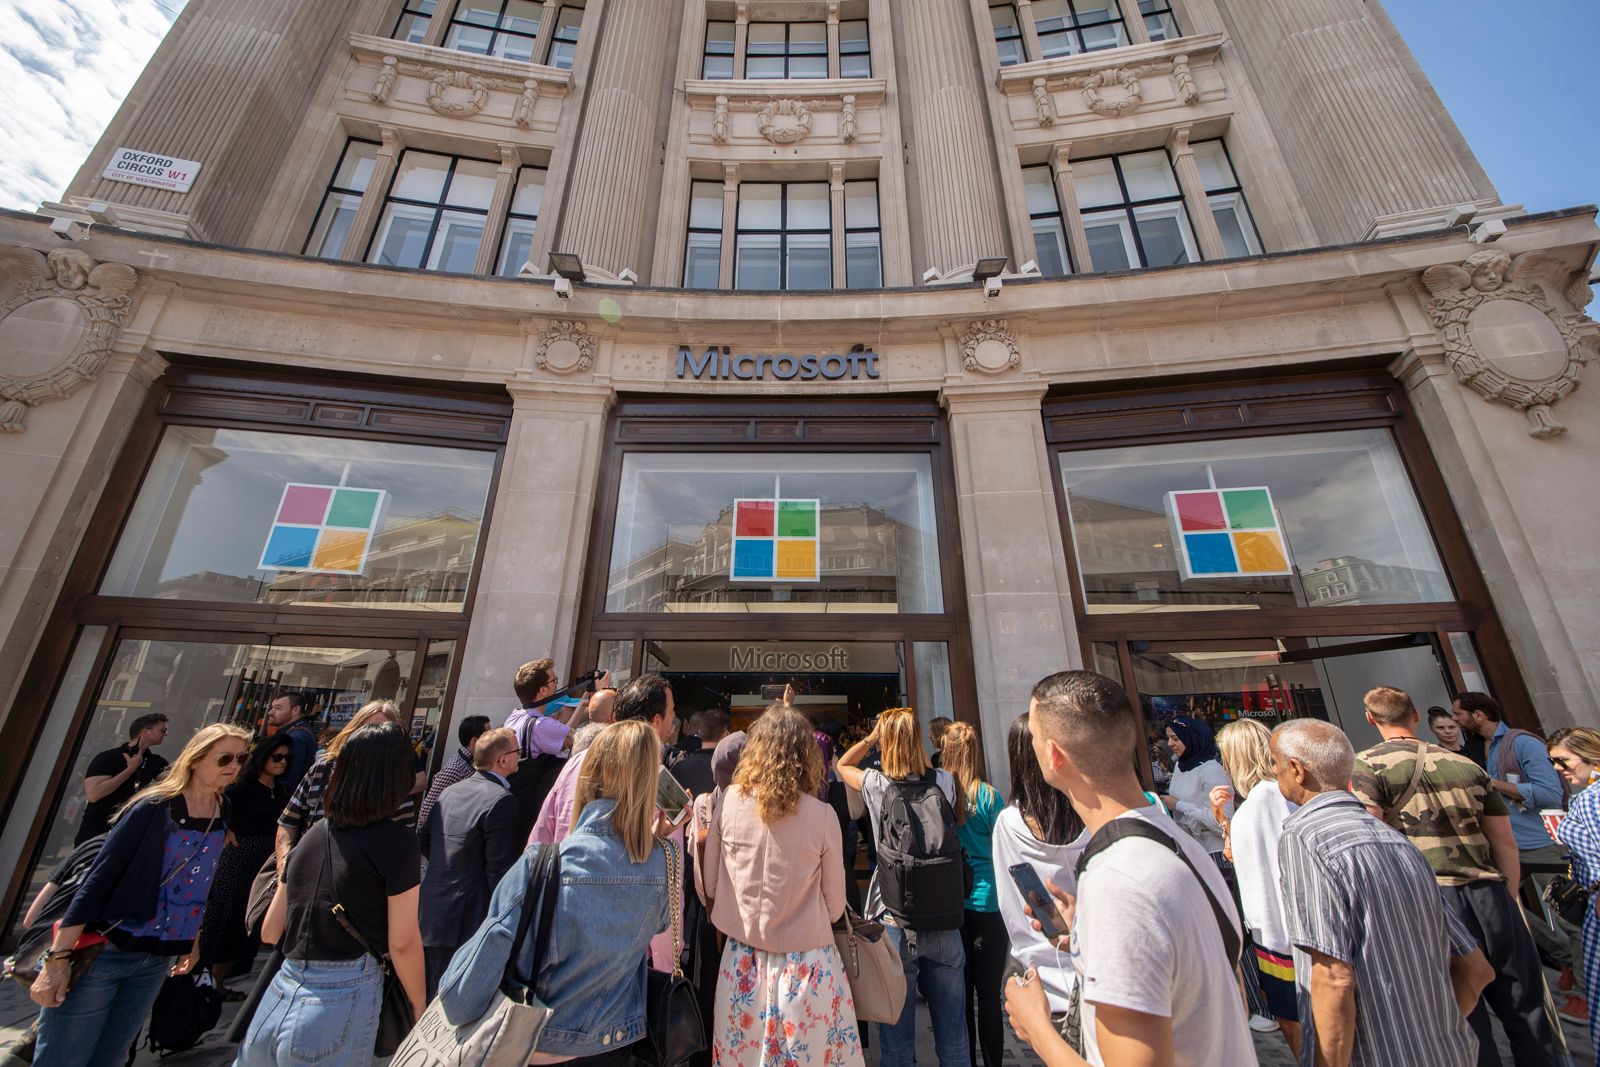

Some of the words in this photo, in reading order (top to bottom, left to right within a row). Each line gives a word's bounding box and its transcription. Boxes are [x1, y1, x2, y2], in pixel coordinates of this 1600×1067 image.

[122, 152, 173, 168] OXFORD
[117, 161, 164, 177] CIRCUS
[168, 169, 188, 181] W1
[135, 177, 177, 188] WESTMINSTER
[677, 343, 880, 380] Microsoft
[730, 646, 848, 671] Microsoft
